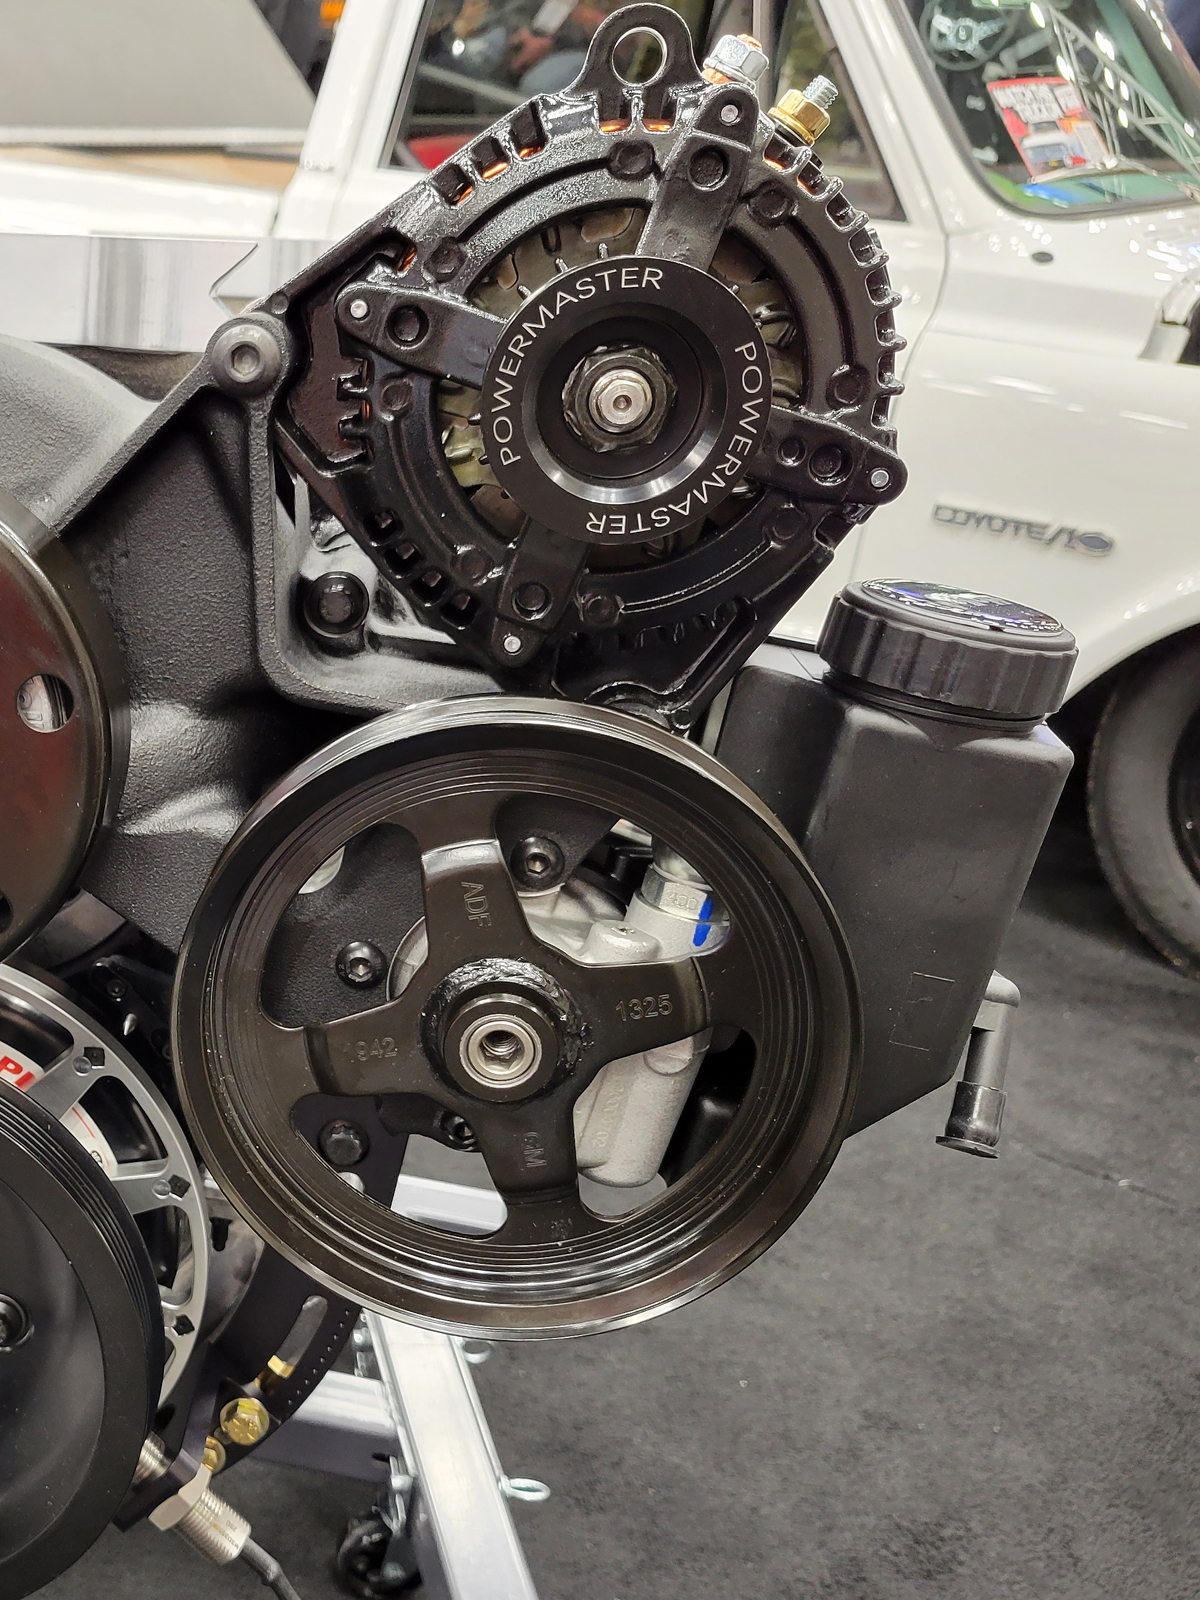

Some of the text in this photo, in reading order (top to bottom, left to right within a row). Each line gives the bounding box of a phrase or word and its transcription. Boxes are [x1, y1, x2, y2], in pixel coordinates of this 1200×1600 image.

[491, 267, 664, 466] POWERMASTER
[585, 341, 764, 535] POWERMASTER
[460, 881, 492, 927] ADF
[615, 993, 673, 1021] 1325
